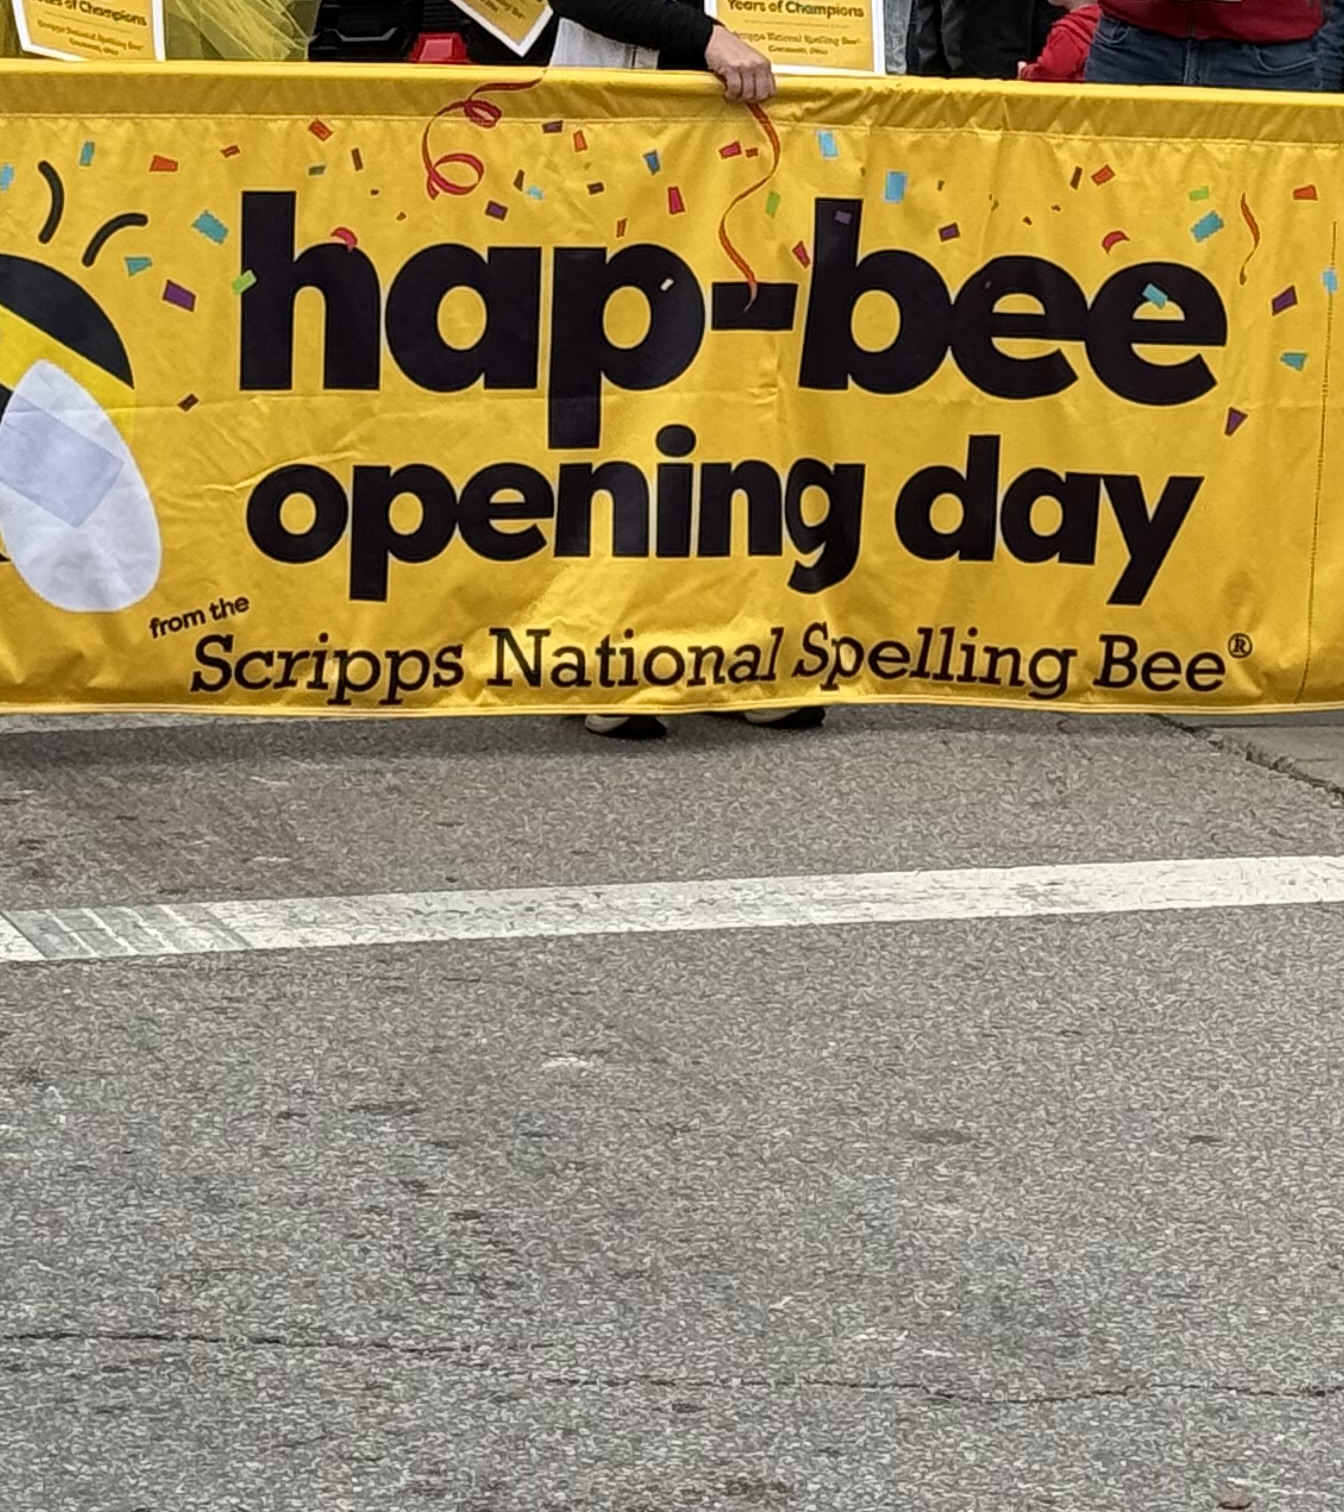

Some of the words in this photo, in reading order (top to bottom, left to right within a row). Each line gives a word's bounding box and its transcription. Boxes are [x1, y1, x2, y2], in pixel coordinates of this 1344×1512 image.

[768, 0, 783, 13] of
[785, 0, 864, 19] Champions
[239, 190, 1228, 449] hap-bee
[246, 423, 866, 602] opening
[894, 433, 1205, 606] day
[149, 607, 206, 639] from
[209, 595, 250, 622] the
[190, 631, 465, 706] Scripps
[486, 626, 785, 689] National
[791, 620, 1078, 701] Spelling
